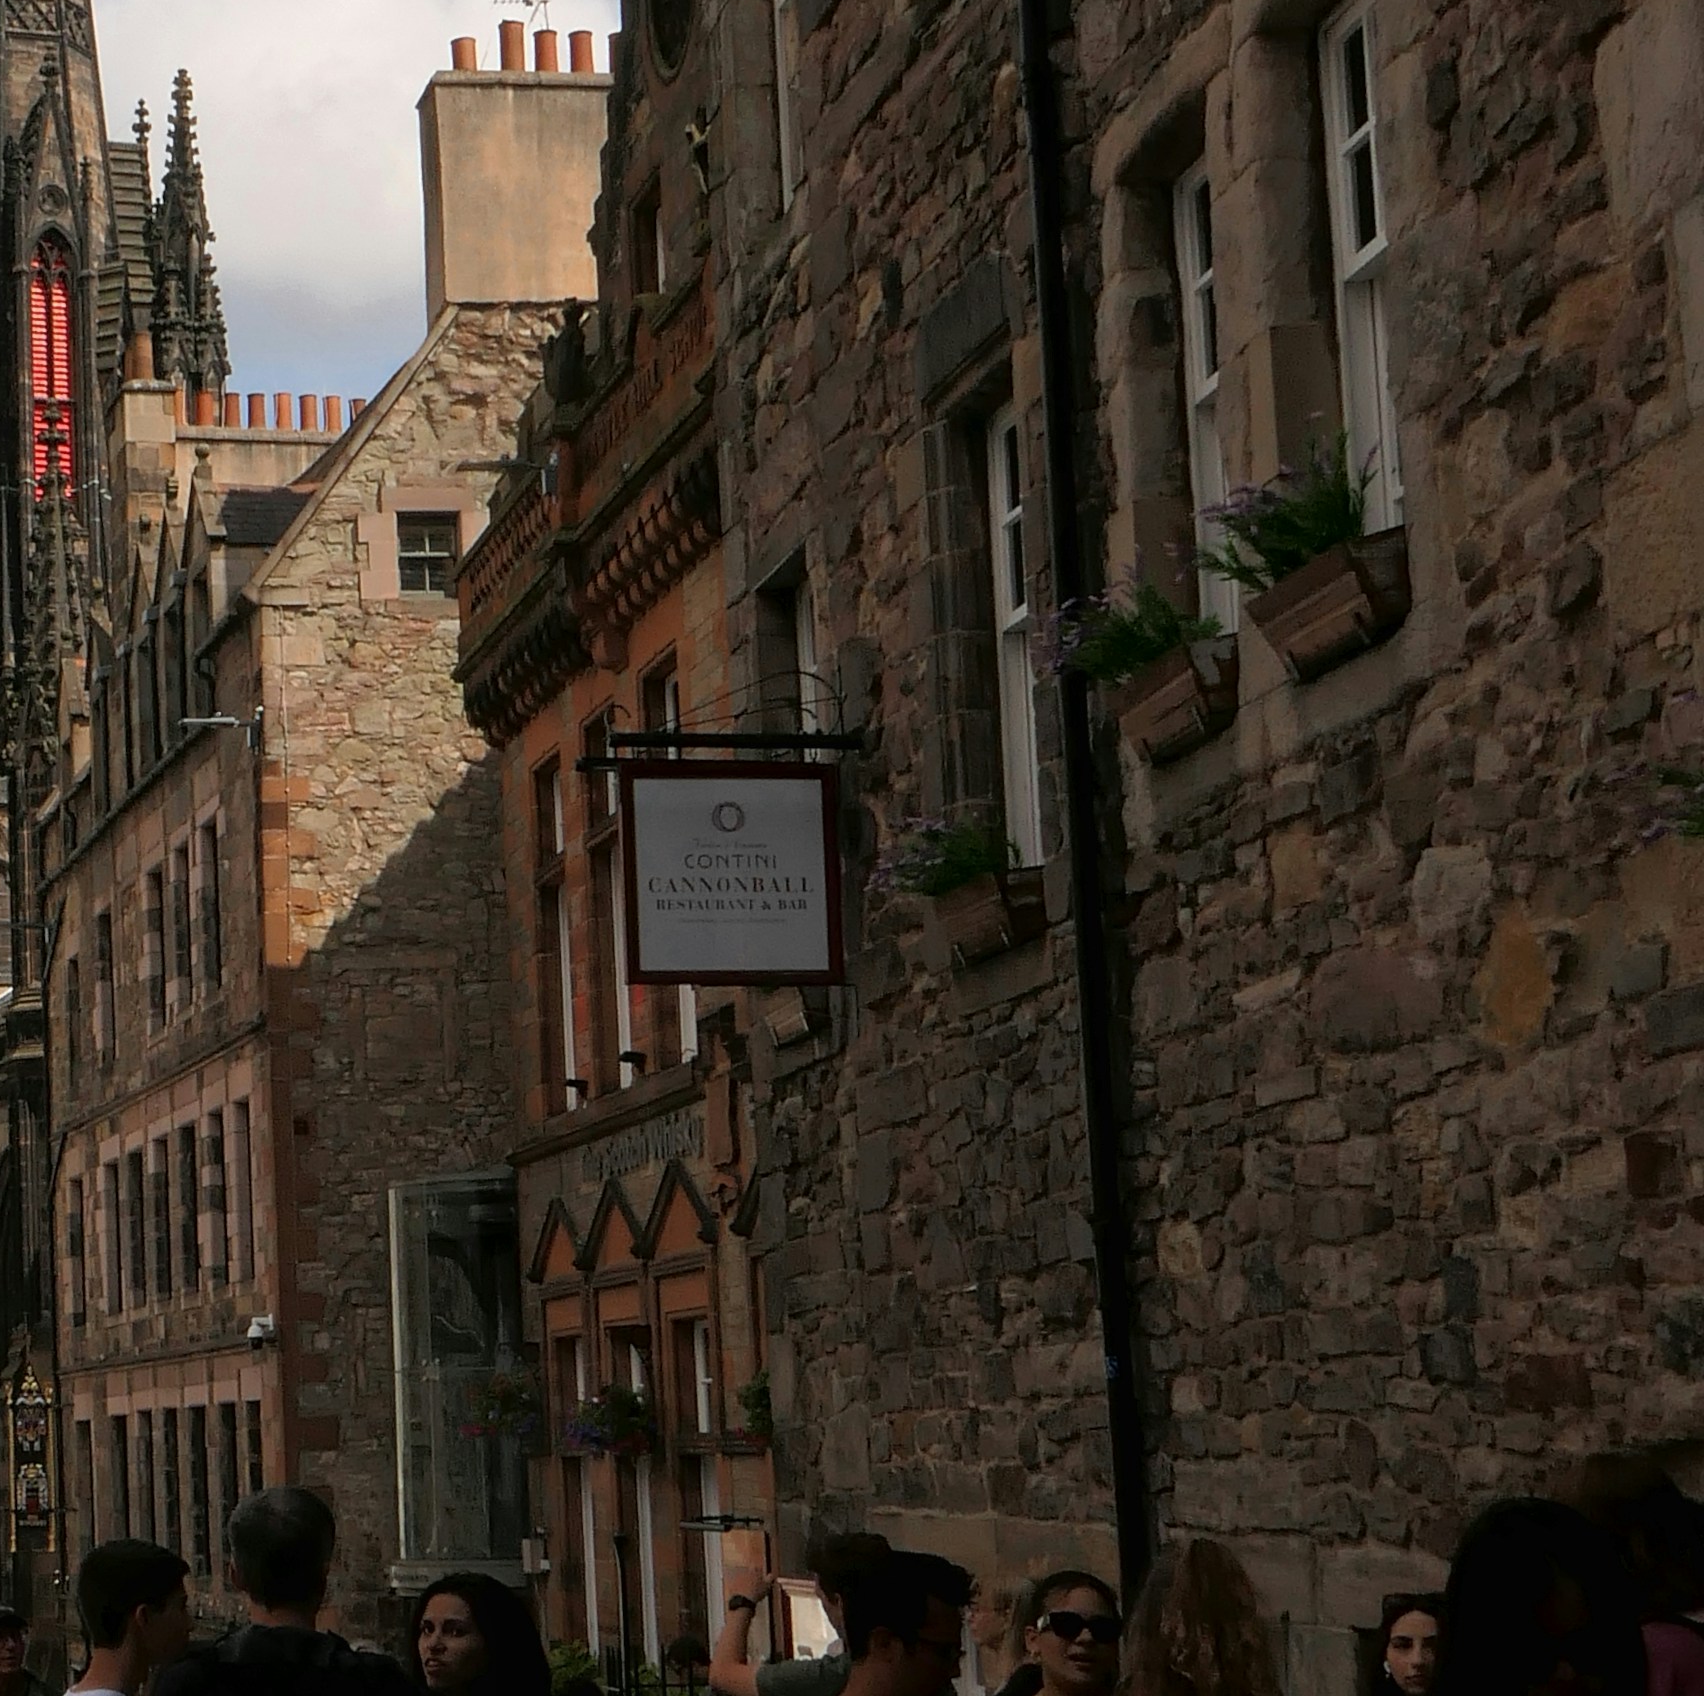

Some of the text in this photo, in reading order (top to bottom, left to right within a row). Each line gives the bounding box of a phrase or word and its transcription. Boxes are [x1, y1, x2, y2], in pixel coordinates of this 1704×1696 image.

[684, 853, 777, 869] CONTINI
[648, 876, 814, 893] CANNONBALL
[656, 898, 808, 910] RESTAURANT & BAR
